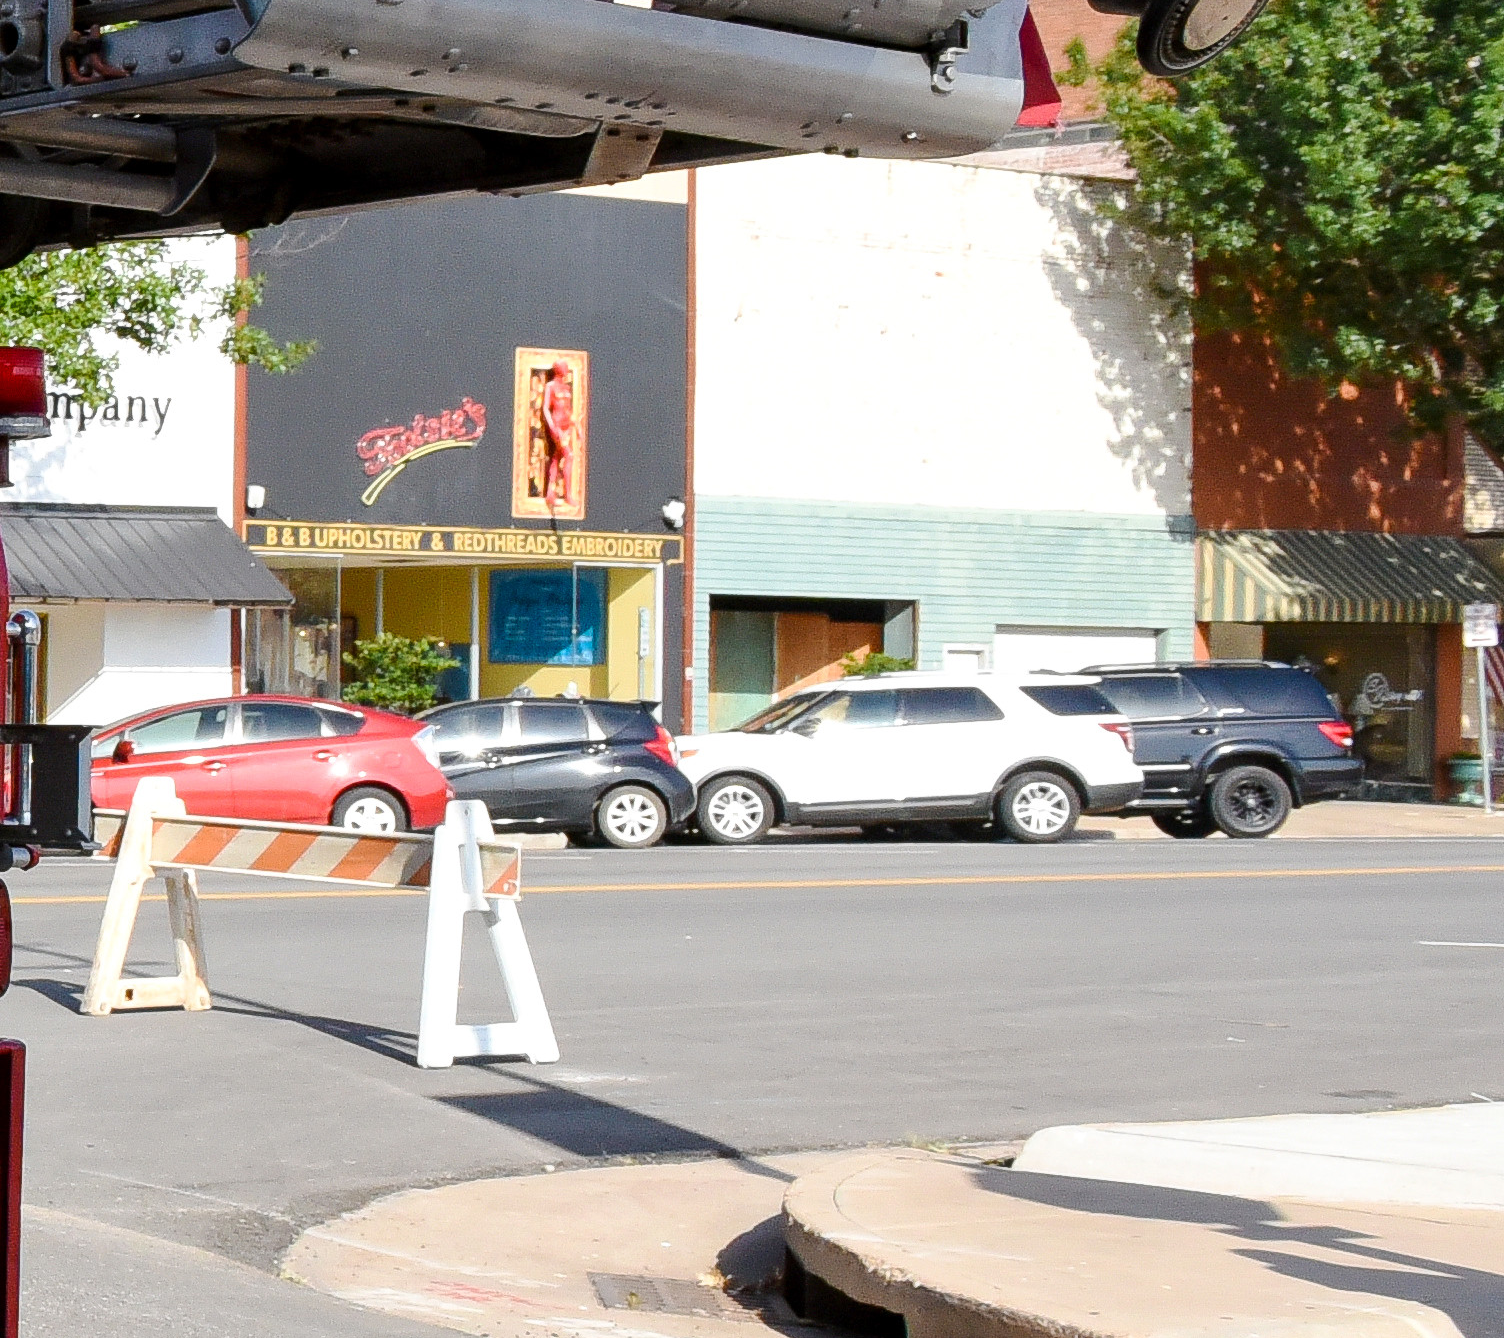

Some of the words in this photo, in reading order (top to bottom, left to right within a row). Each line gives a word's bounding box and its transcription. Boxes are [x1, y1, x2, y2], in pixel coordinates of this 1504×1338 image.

[266, 526, 278, 546] B
[281, 527, 295, 546] &
[299, 527, 311, 547] B
[314, 528, 423, 549] UPHOLSTERY
[430, 532, 444, 551] &
[453, 533, 558, 555] REDTHREADS
[562, 536, 664, 558] EMBROIDERY
